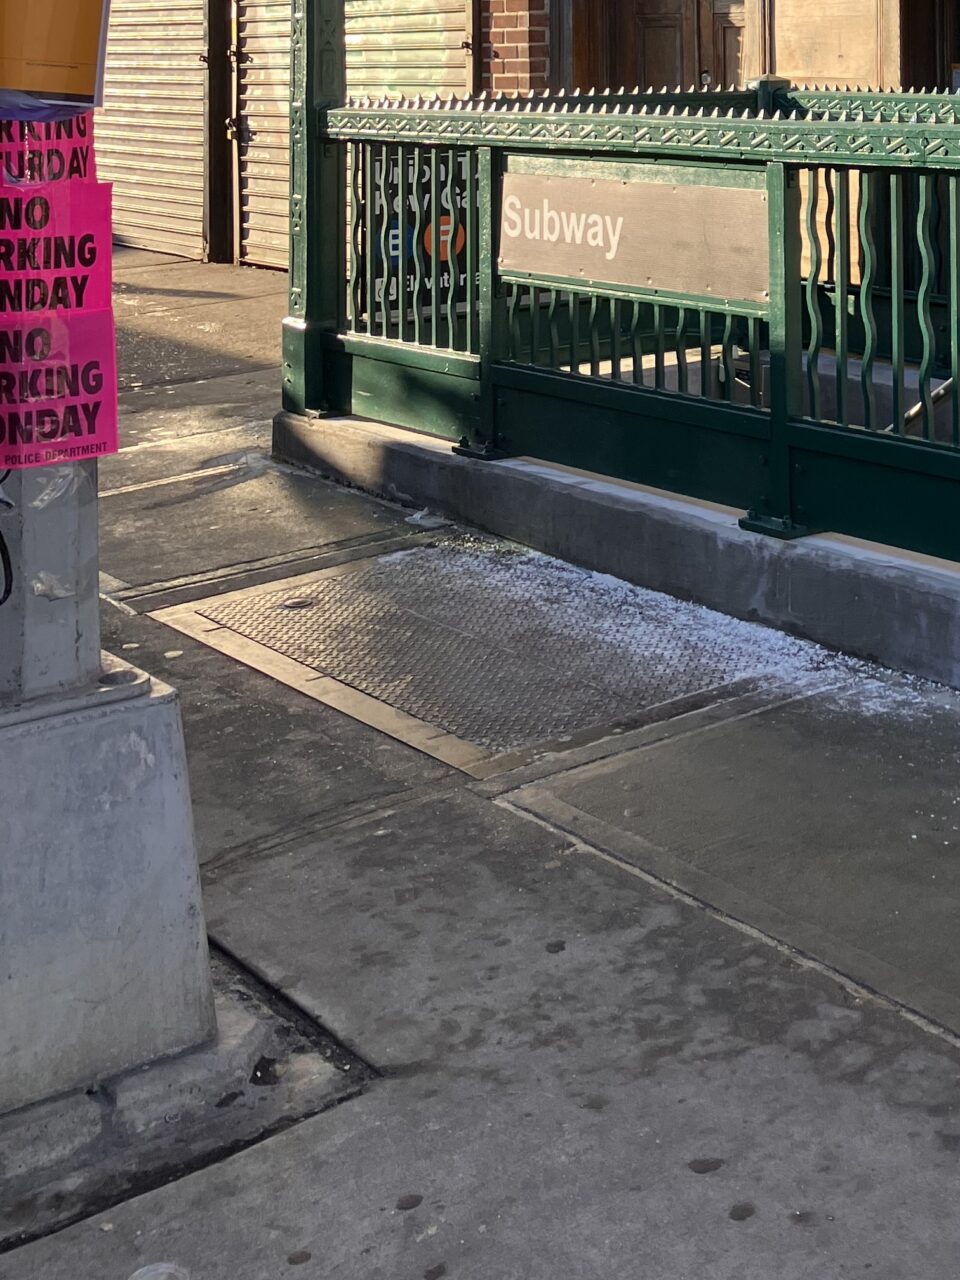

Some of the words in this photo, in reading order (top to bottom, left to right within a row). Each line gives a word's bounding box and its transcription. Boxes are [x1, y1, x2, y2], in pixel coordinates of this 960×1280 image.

[0, 145, 90, 182] URDAY
[0, 196, 50, 232] NO
[503, 193, 624, 260] Subway
[0, 327, 50, 365] NO
[4, 452, 40, 465] POLICE
[45, 441, 108, 461] DEPARTMENT
